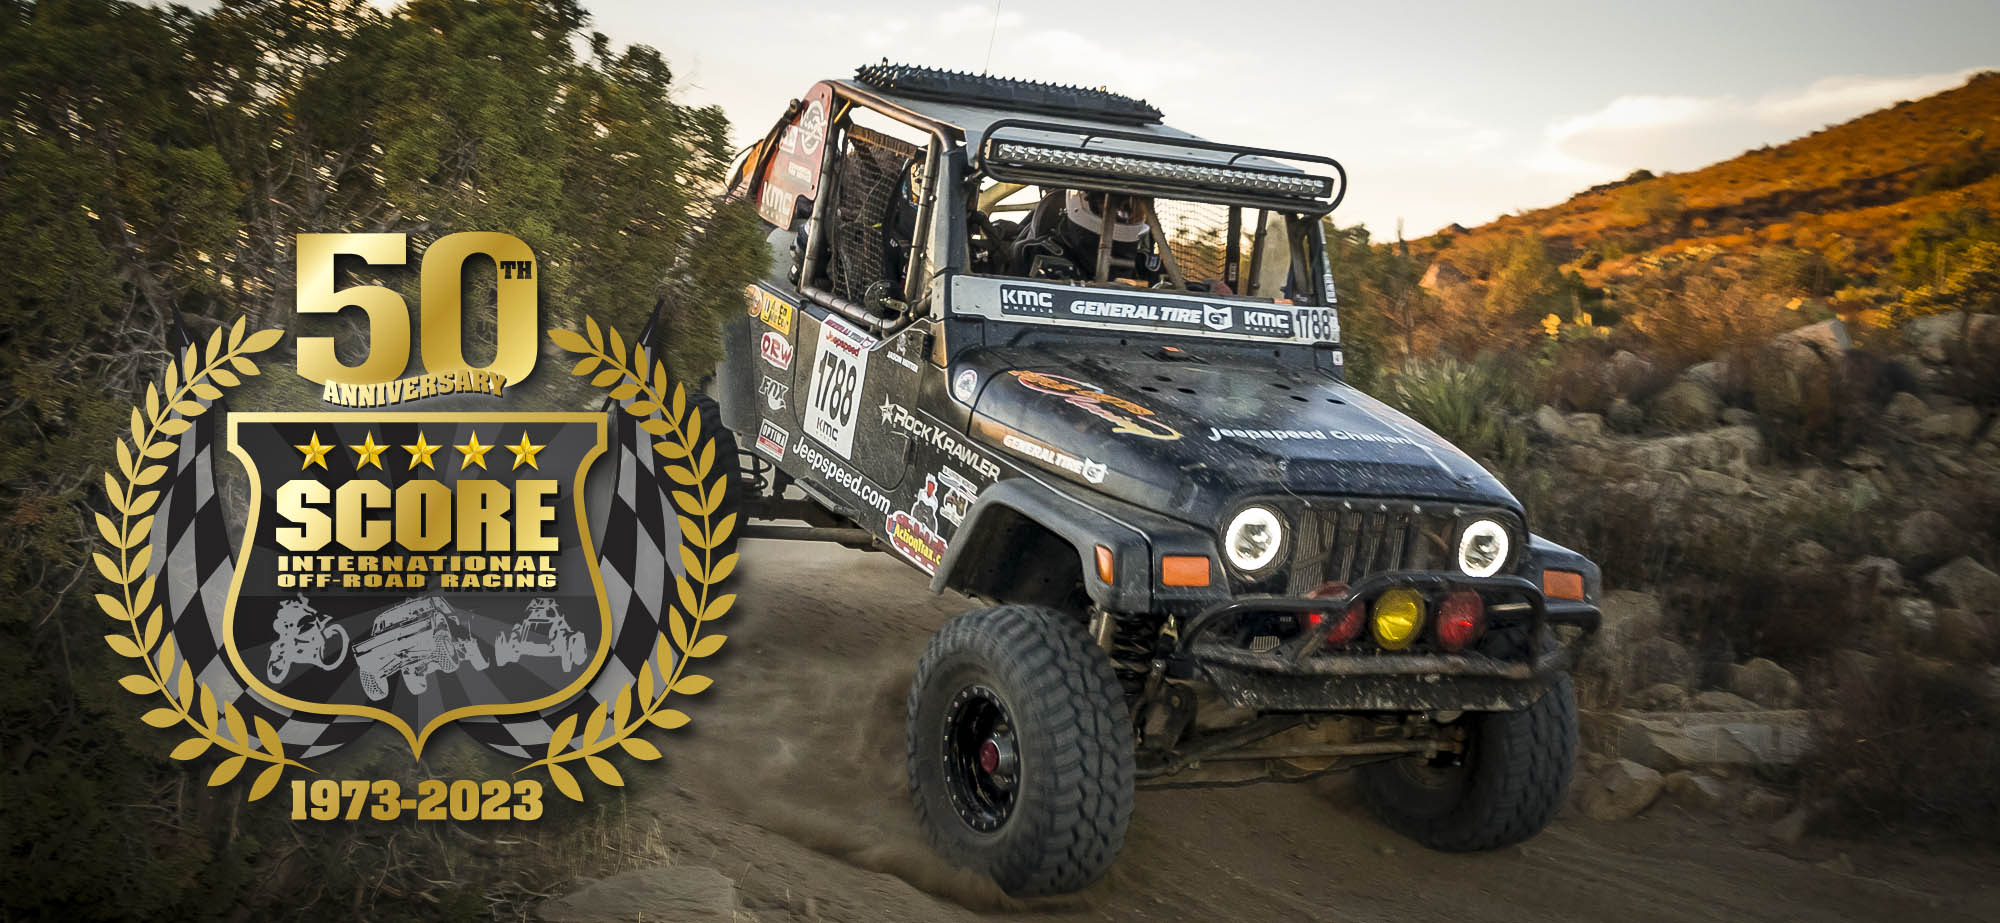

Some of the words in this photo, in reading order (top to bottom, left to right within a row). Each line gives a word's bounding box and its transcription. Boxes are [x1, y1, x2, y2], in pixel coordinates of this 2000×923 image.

[1002, 289, 1053, 307] KMC
[1070, 300, 1159, 321] GENERAL
[1160, 306, 1203, 324] TIRE
[1244, 311, 1290, 328] KMC
[1296, 309, 1331, 340] 1788
[759, 376, 789, 400] FOX
[815, 350, 857, 427] 1788
[792, 436, 891, 514] Jeepspeed.com
